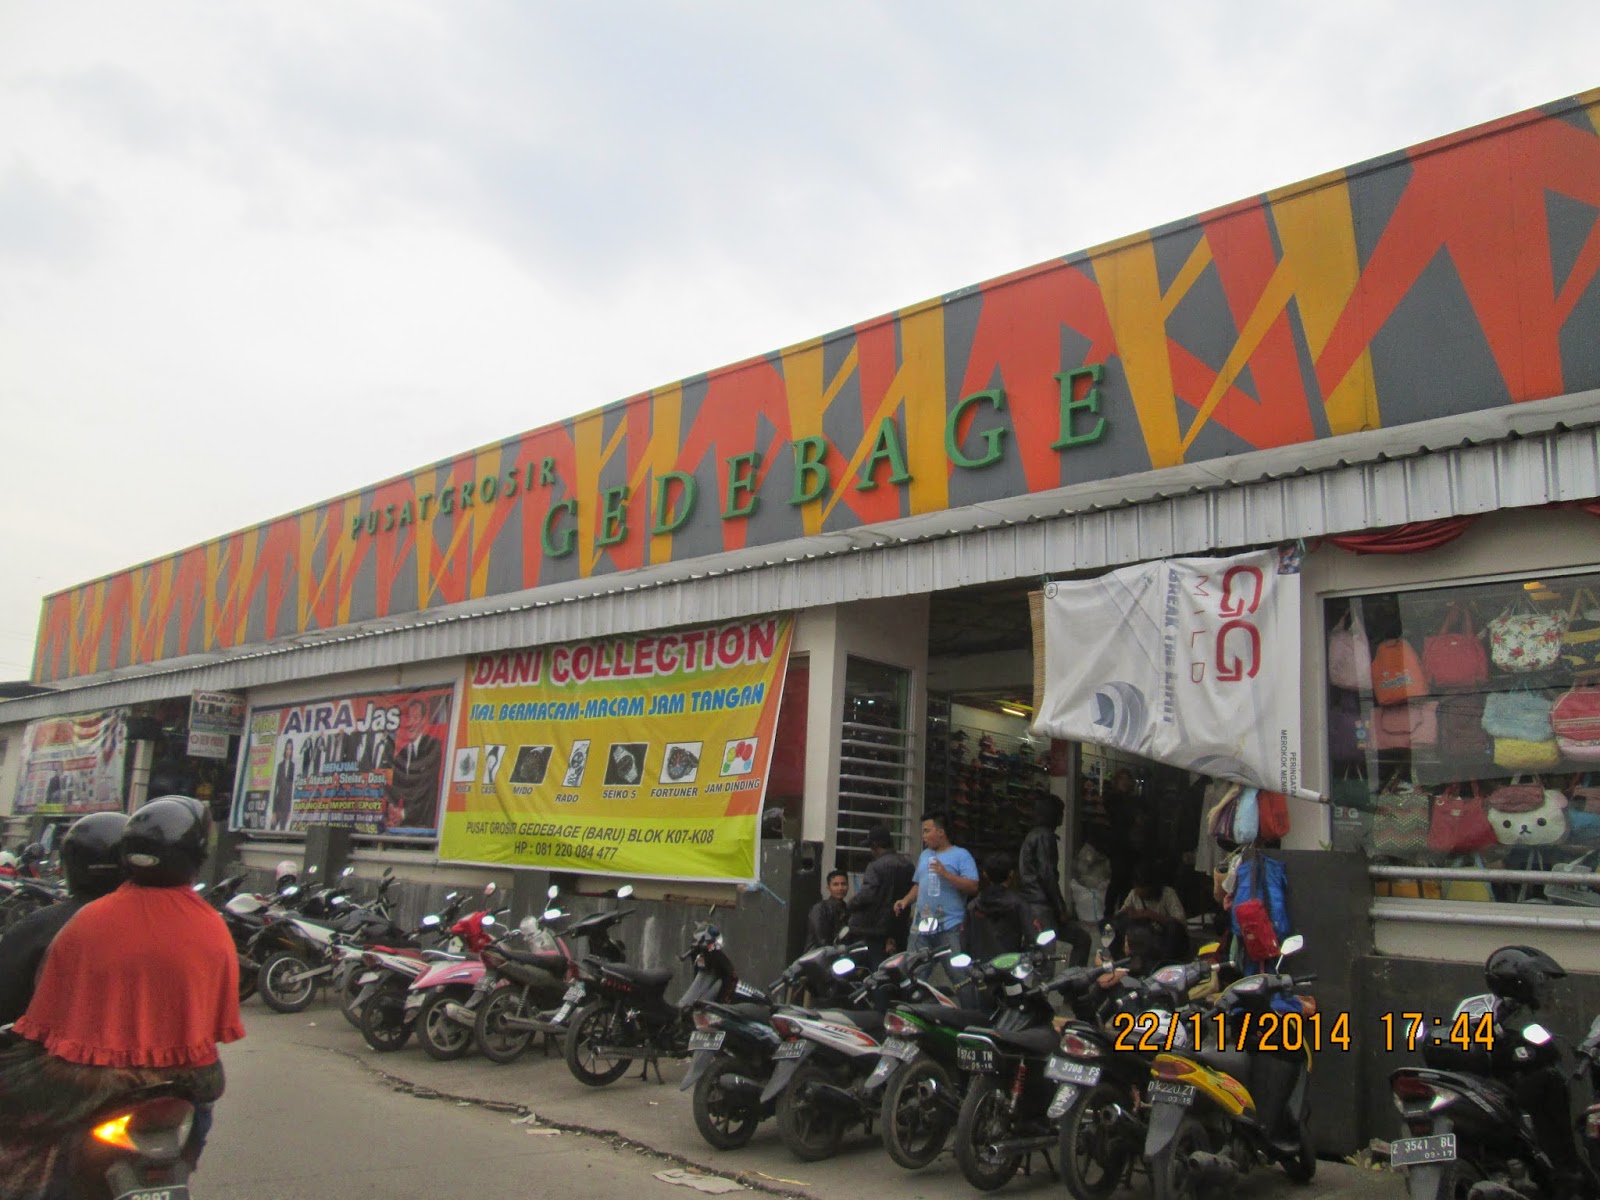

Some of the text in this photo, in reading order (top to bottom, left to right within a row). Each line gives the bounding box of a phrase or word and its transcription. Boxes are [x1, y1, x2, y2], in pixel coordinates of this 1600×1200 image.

[543, 364, 1106, 559] GEDEBAGE
[351, 457, 557, 540] PUSAT GROSIR
[1216, 564, 1263, 683] GG
[473, 621, 778, 687] DANI COLLECTION
[500, 695, 644, 721] BERMACAM-MACAM
[649, 694, 685, 715] JAM
[691, 683, 765, 712] TANGAN
[283, 701, 401, 735] AIRA Jas
[1280, 729, 1288, 768] MEROKOK
[512, 786, 533, 795] MIDO
[602, 790, 625, 799] SEIKO
[650, 787, 699, 798] FORTUNER
[704, 779, 760, 793] JAM DINDING
[555, 793, 579, 803] RADO
[466, 821, 715, 844] PUSAT GROSIR GEDEBAGE (BARU) BLOK K07-K08
[514, 843, 528, 855] HP
[535, 843, 555, 857] 081
[555, 844, 574, 858] 220
[575, 845, 595, 859] 084
[596, 847, 619, 861] 477
[1050, 1057, 1056, 1068] D
[1088, 1067, 1100, 1077] FS
[1182, 1085, 1196, 1096] ZT
[1392, 1137, 1454, 1154] Z 3541 BL
